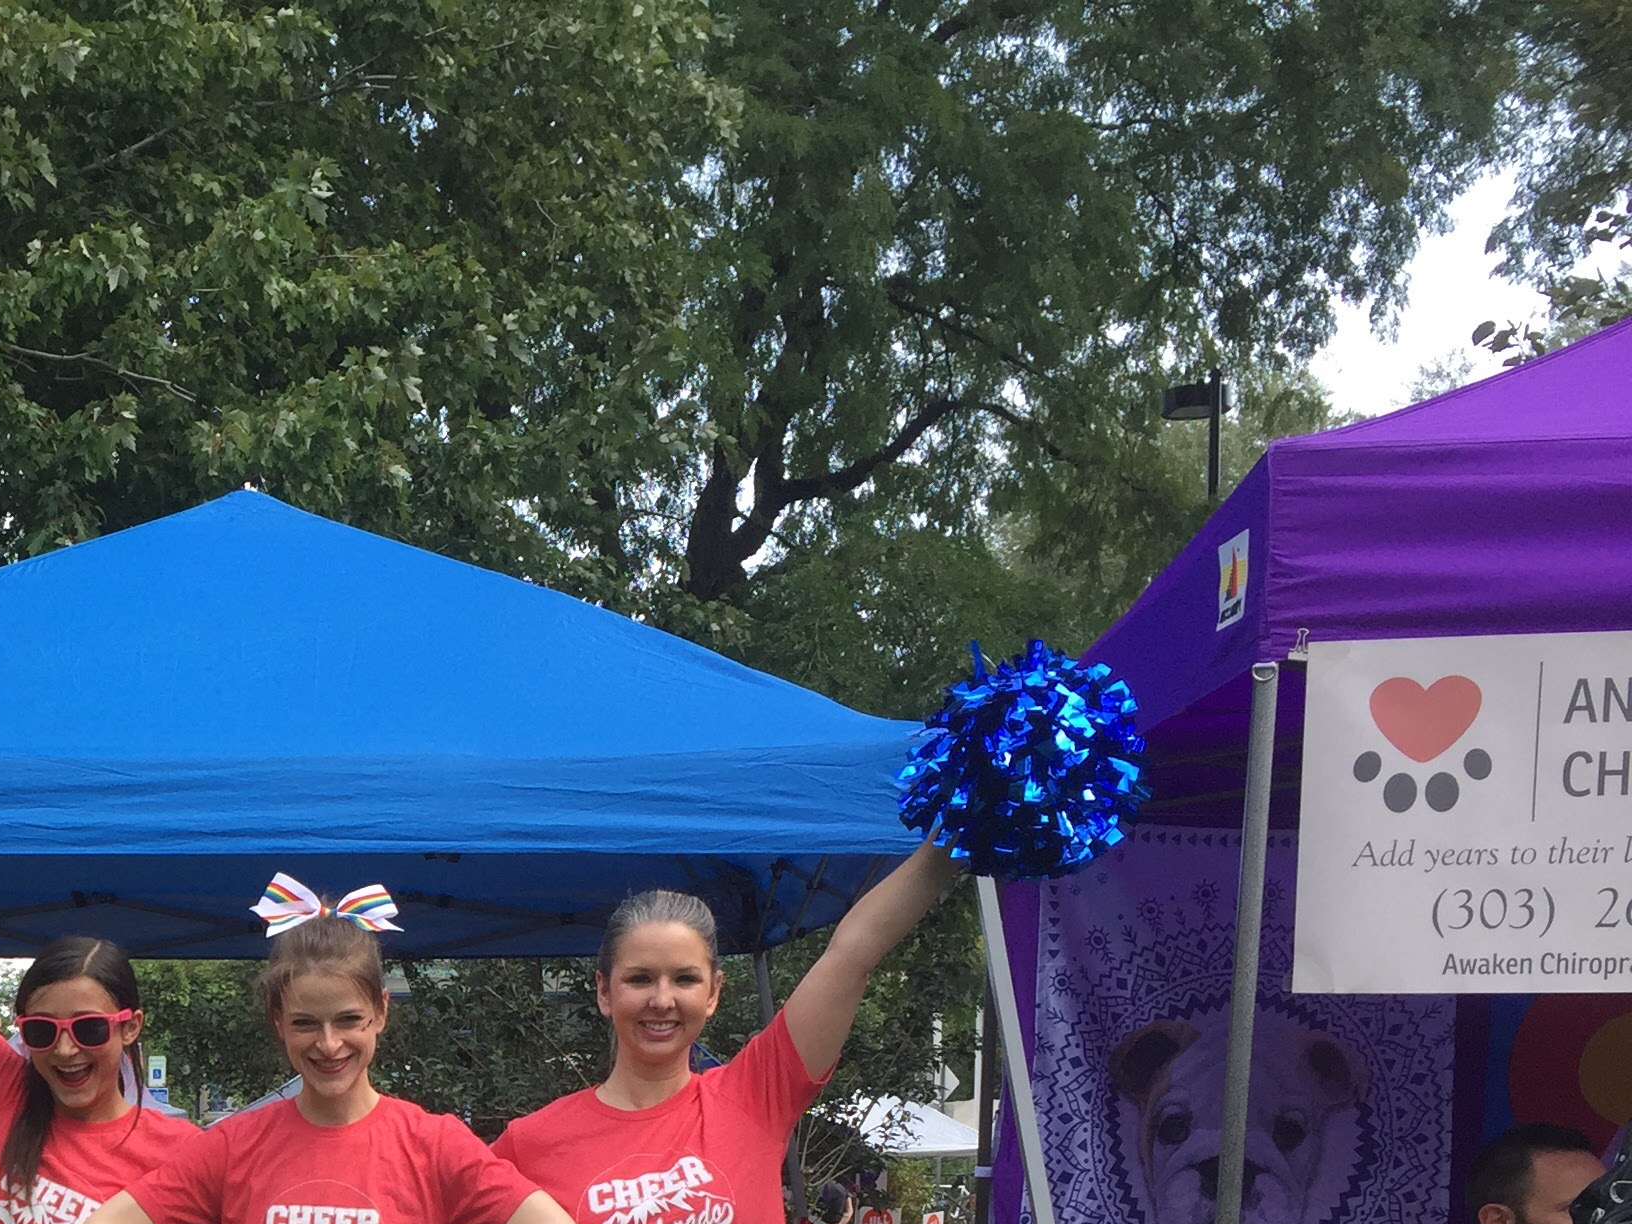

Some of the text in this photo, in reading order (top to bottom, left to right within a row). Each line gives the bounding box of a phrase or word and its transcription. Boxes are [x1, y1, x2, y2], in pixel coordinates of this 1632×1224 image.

[1352, 839, 1415, 867] Add
[1424, 848, 1499, 873] years
[1511, 846, 1537, 865] to
[1548, 836, 1615, 864] their
[1432, 886, 1556, 939] (303)
[1442, 953, 1532, 976] Awaken
[588, 1156, 714, 1214] CHEER
